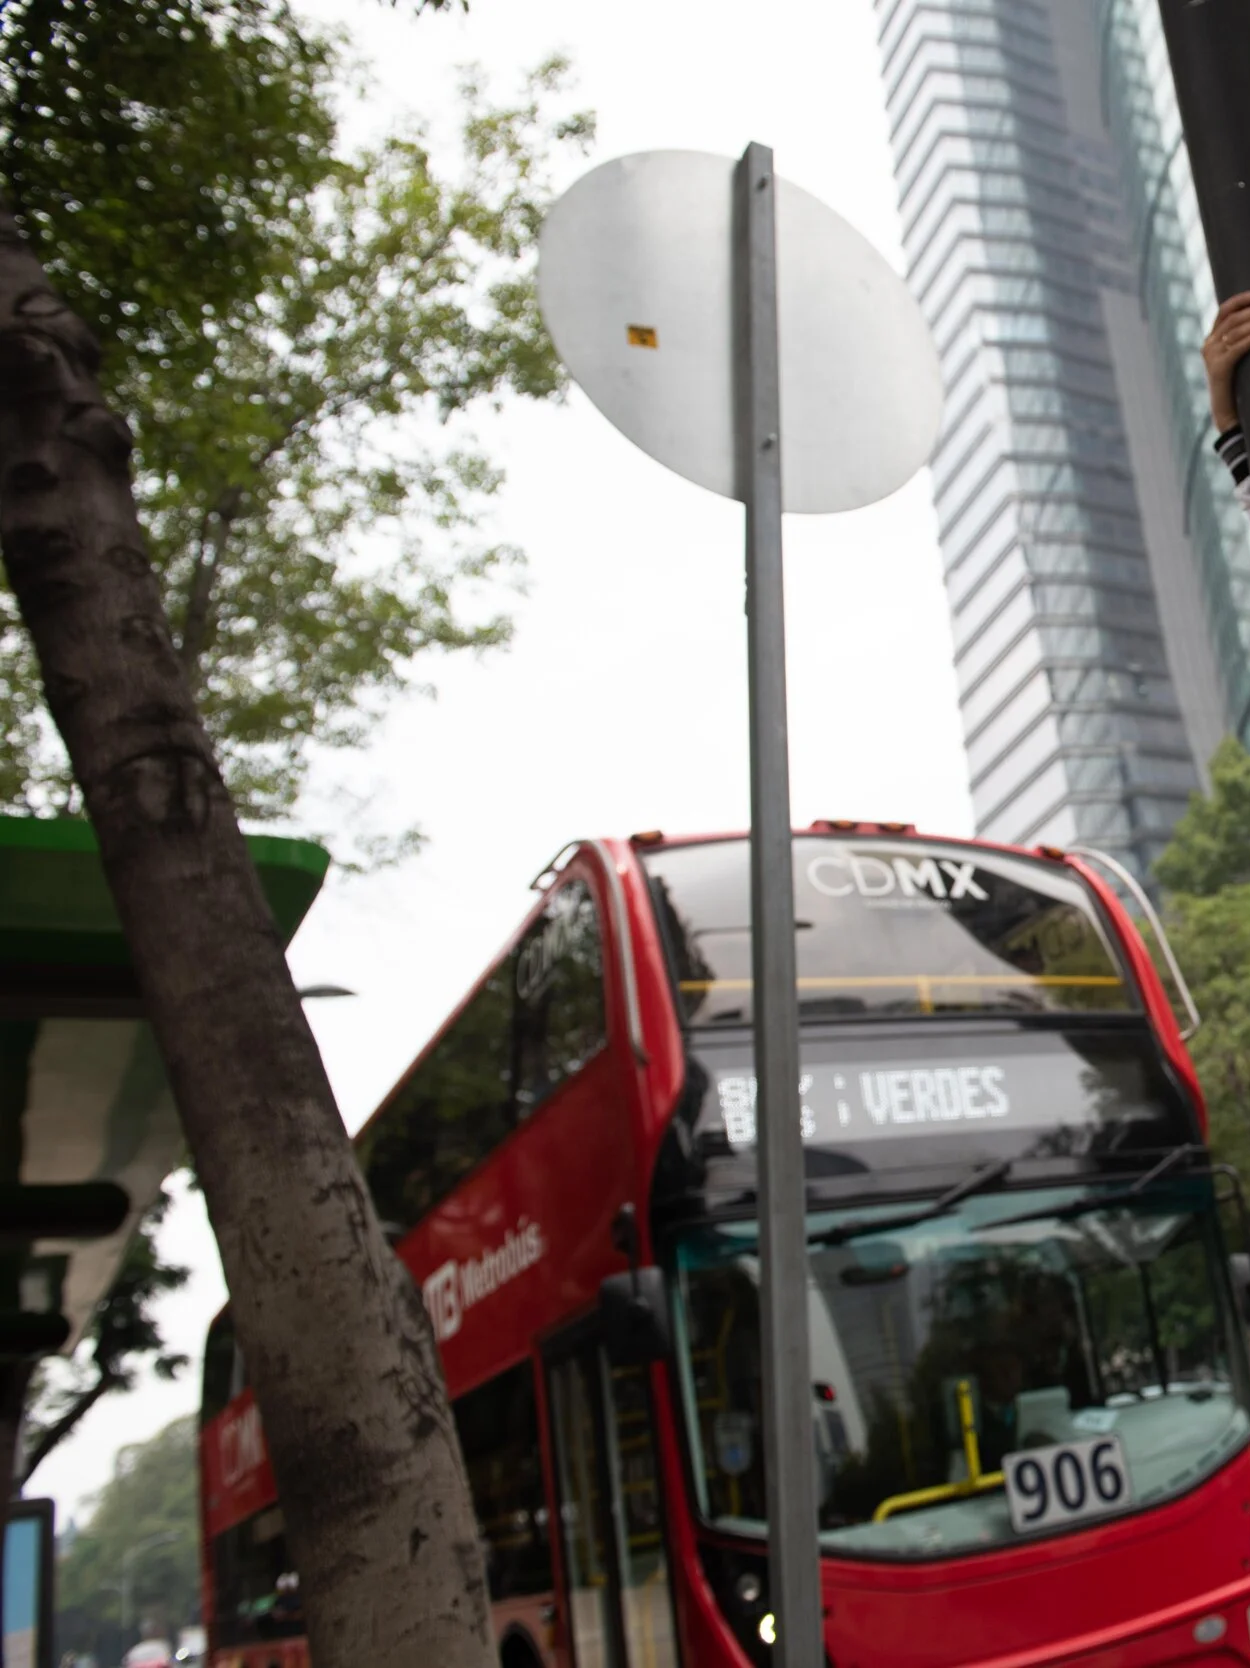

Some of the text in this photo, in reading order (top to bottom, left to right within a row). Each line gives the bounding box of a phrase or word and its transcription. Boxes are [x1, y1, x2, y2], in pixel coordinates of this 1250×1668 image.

[808, 856, 989, 900] CDMX
[860, 1066, 1009, 1125] VERDES
[1014, 1442, 1122, 1519] 906
